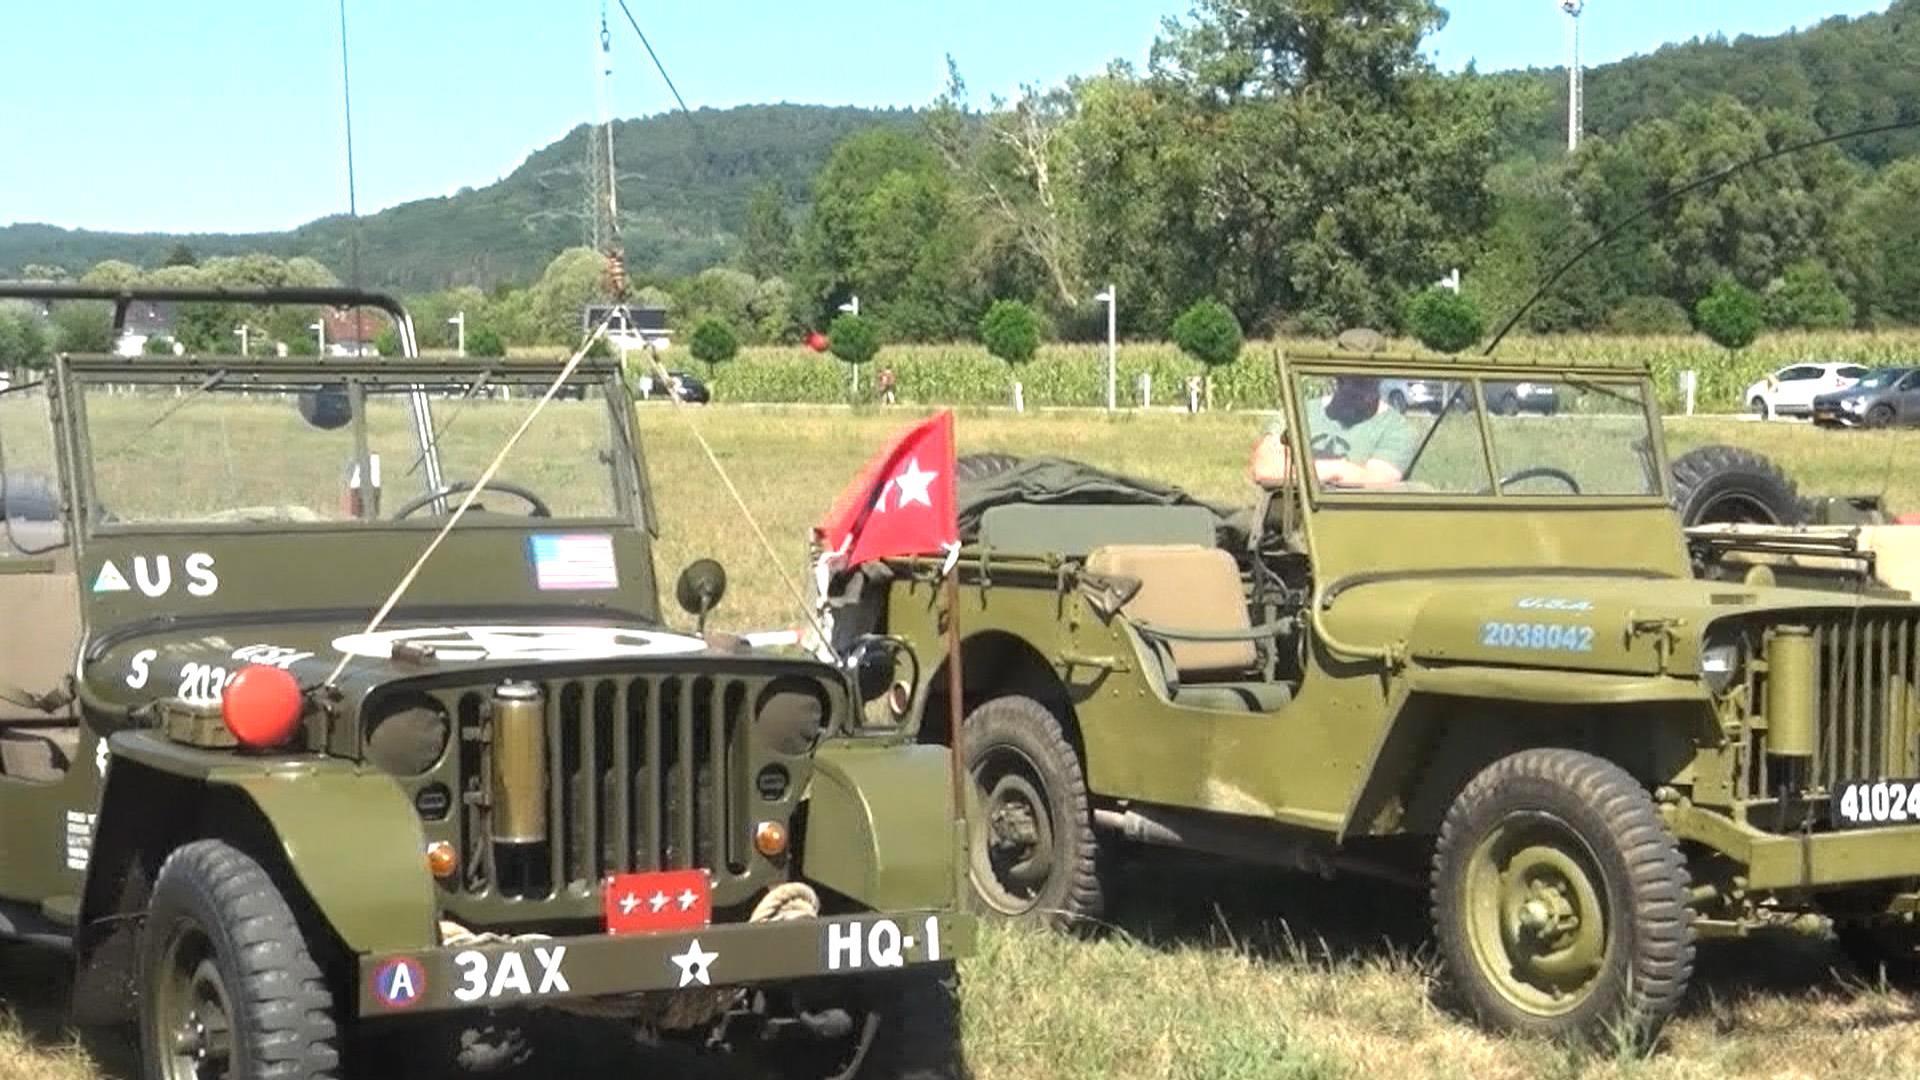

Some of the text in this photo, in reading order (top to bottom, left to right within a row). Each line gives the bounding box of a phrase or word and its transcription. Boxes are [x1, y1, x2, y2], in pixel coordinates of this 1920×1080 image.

[1483, 622, 1595, 651] 2038042
[828, 915, 940, 970] HQ-1
[389, 962, 415, 999] A
[453, 945, 570, 1001] 3AX
